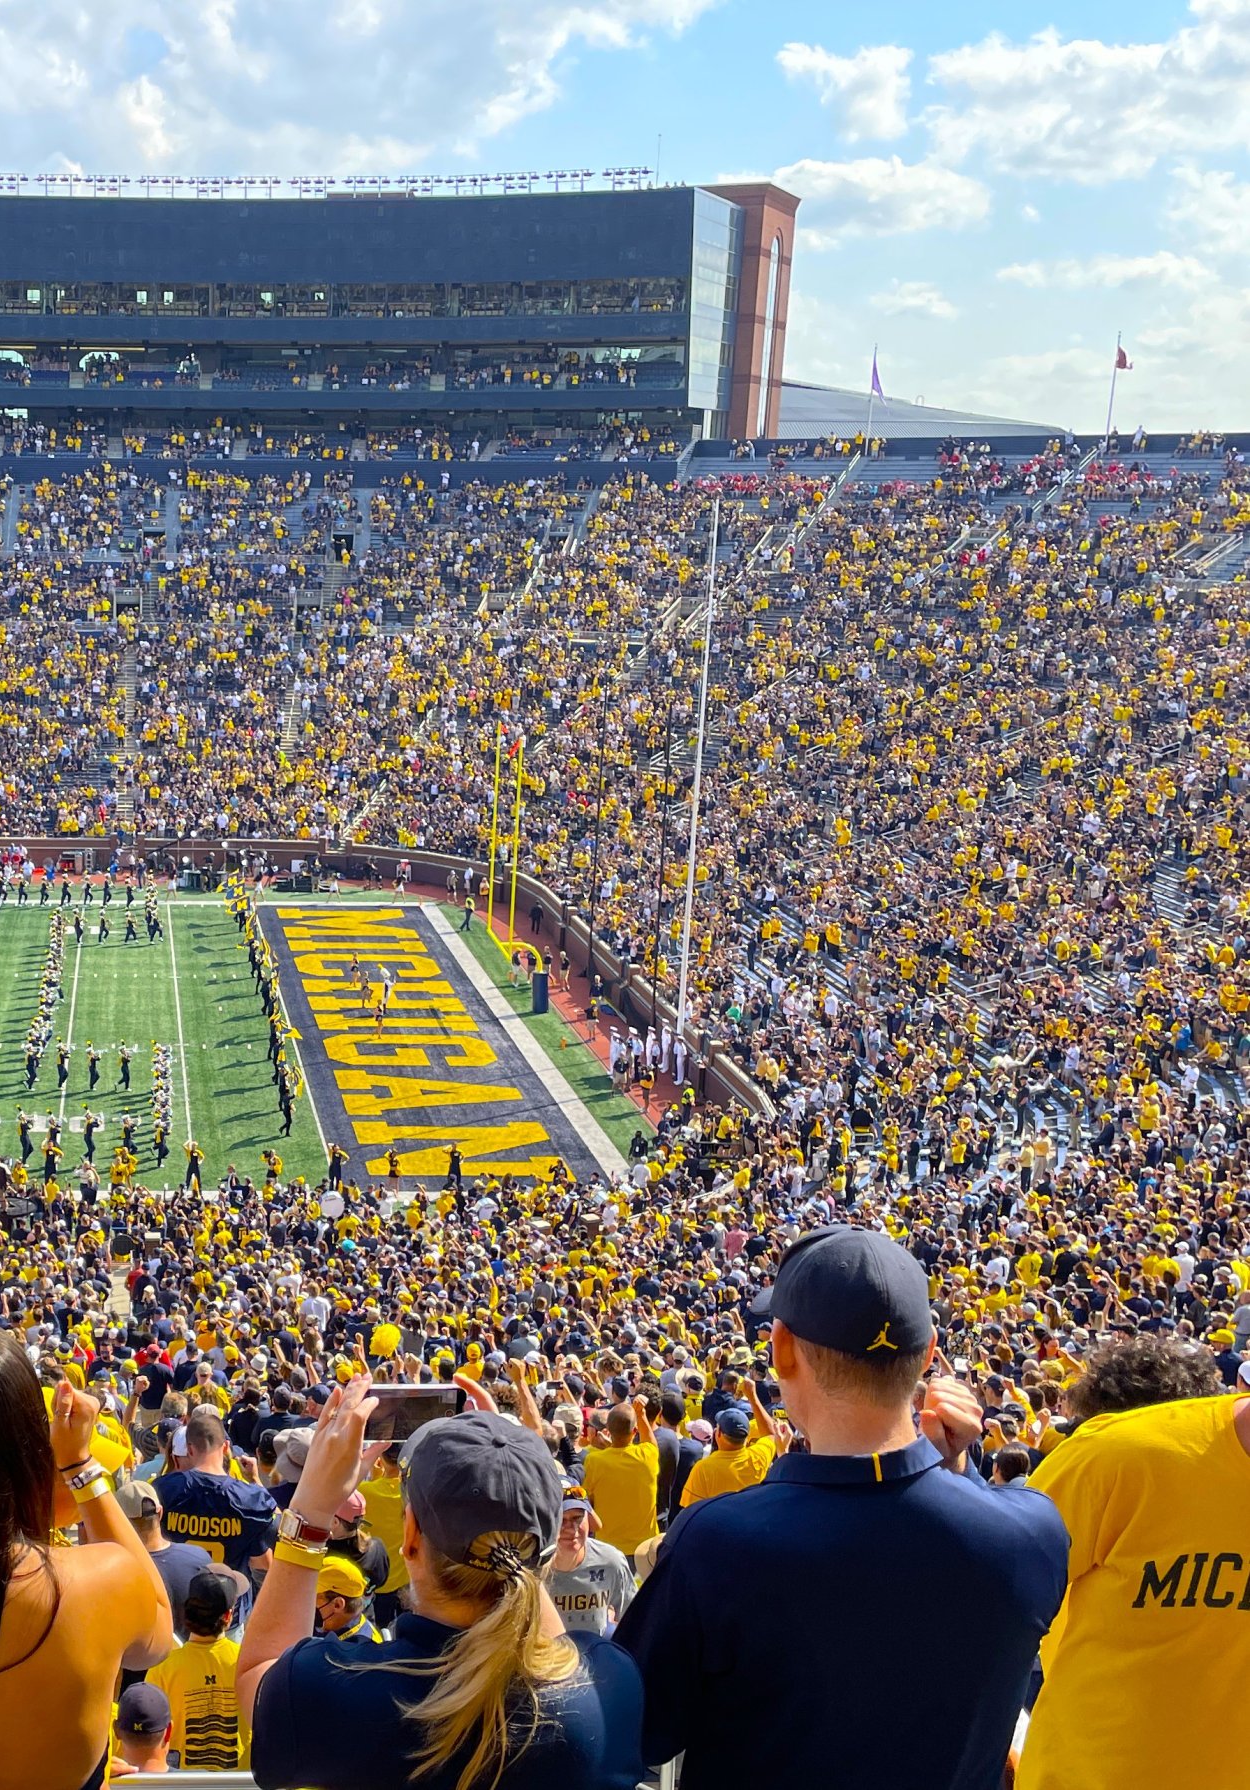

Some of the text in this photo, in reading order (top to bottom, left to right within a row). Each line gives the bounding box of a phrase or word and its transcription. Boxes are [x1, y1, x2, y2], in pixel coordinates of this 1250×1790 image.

[276, 908, 577, 1182] MICHIGAN
[167, 1511, 242, 1537] WOODSON
[589, 1568, 605, 1582] M
[1132, 1552, 1250, 1611] MIC
[553, 1590, 610, 1611] HIGAN
[204, 1674, 217, 1685] M
